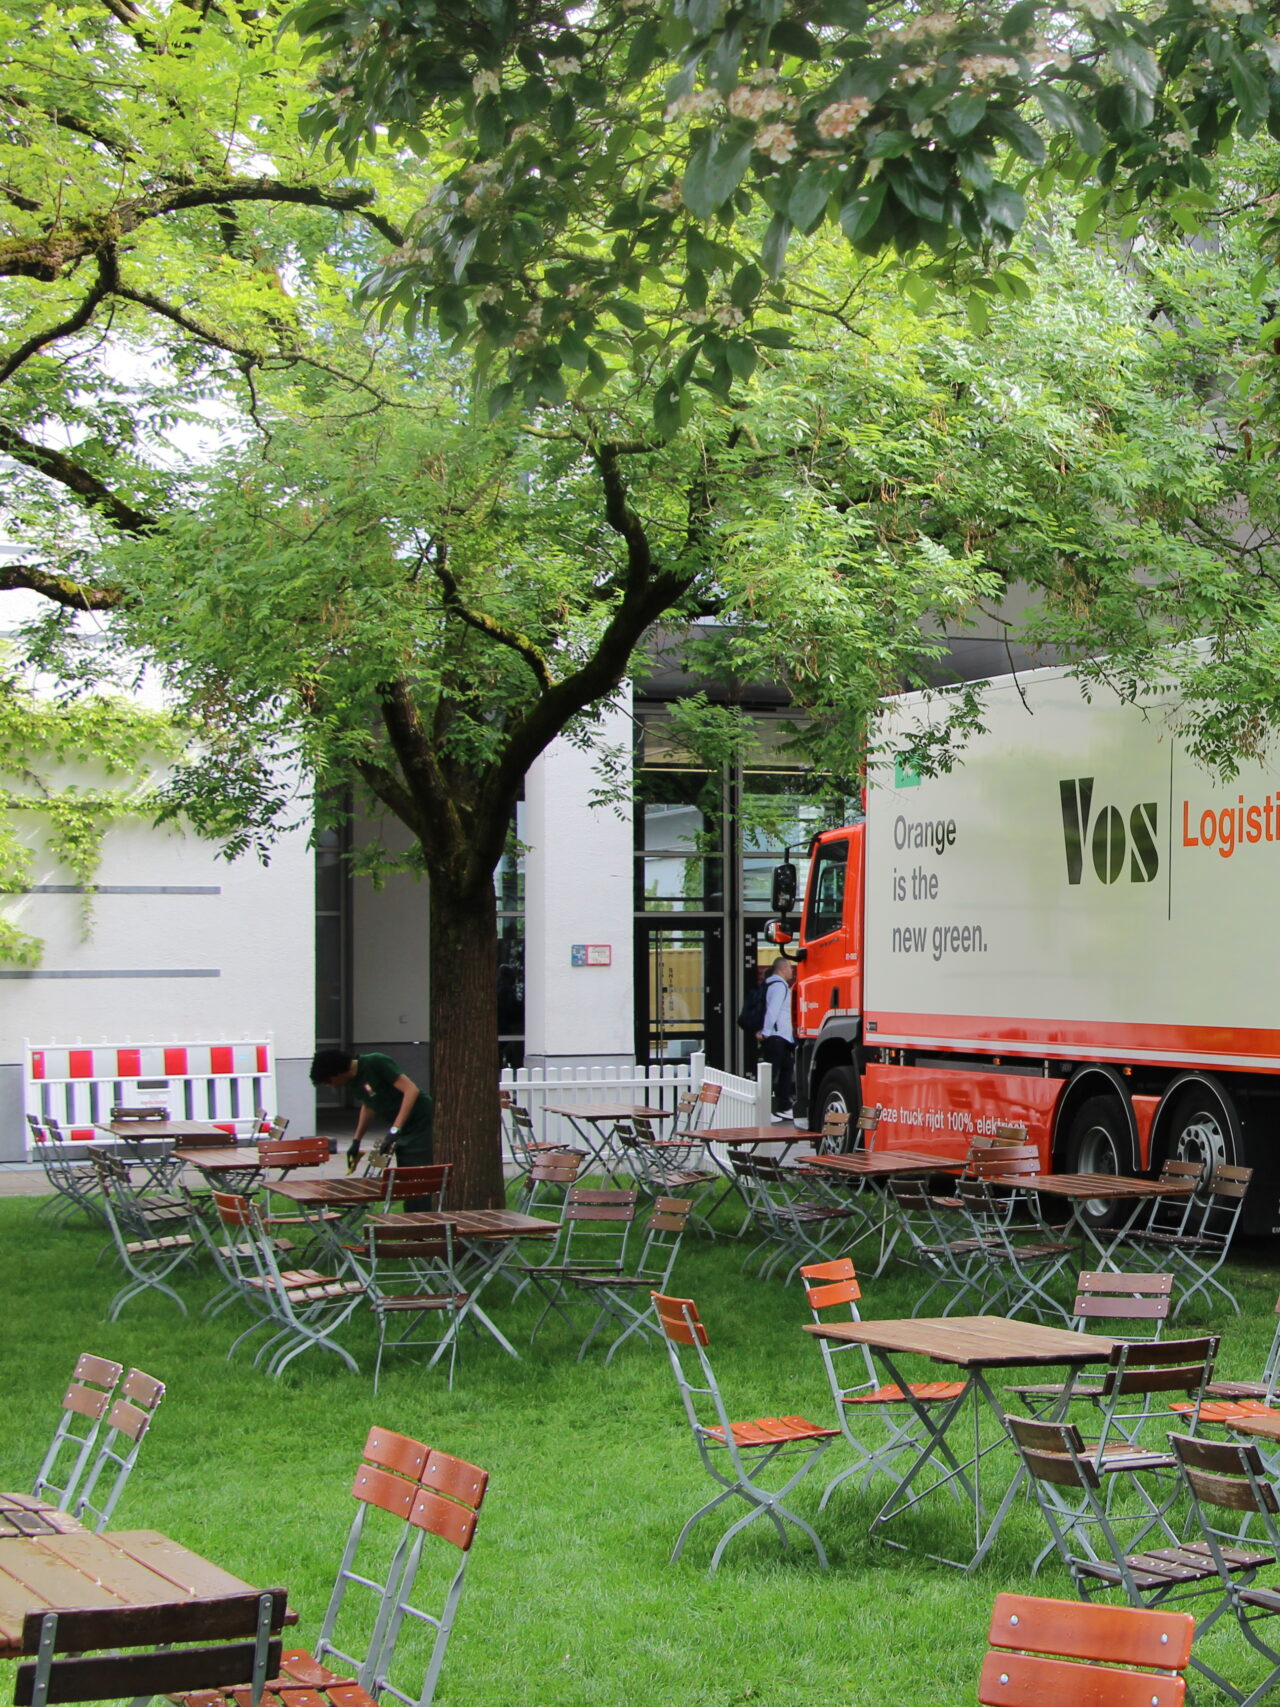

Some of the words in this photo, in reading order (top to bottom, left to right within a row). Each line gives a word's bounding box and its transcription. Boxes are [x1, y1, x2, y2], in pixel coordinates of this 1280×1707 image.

[893, 814, 956, 855] Orange
[1059, 777, 1159, 885] Vos
[893, 868, 906, 902] is
[911, 866, 938, 901] the
[892, 926, 927, 954] new
[932, 922, 988, 961] green.
[900, 1107, 923, 1125] truck
[925, 1109, 944, 1132] rijdt
[947, 1112, 973, 1132] 100%
